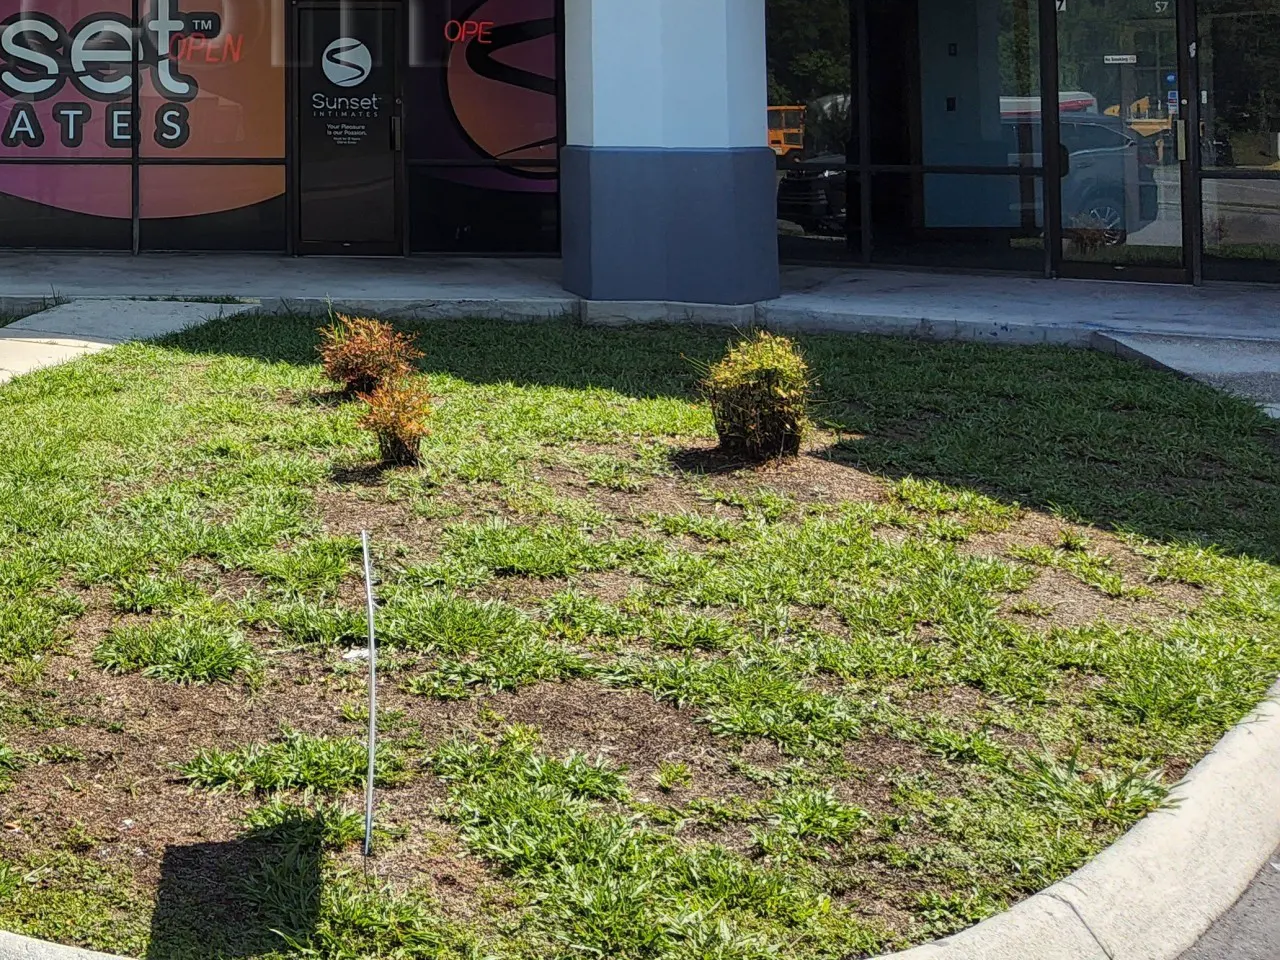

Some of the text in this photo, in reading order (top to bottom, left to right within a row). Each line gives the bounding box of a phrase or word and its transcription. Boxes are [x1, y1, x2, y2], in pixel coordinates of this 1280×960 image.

[444, 19, 494, 44] OPE
[168, 32, 244, 62] OPEN
[312, 93, 379, 110] Sunset
